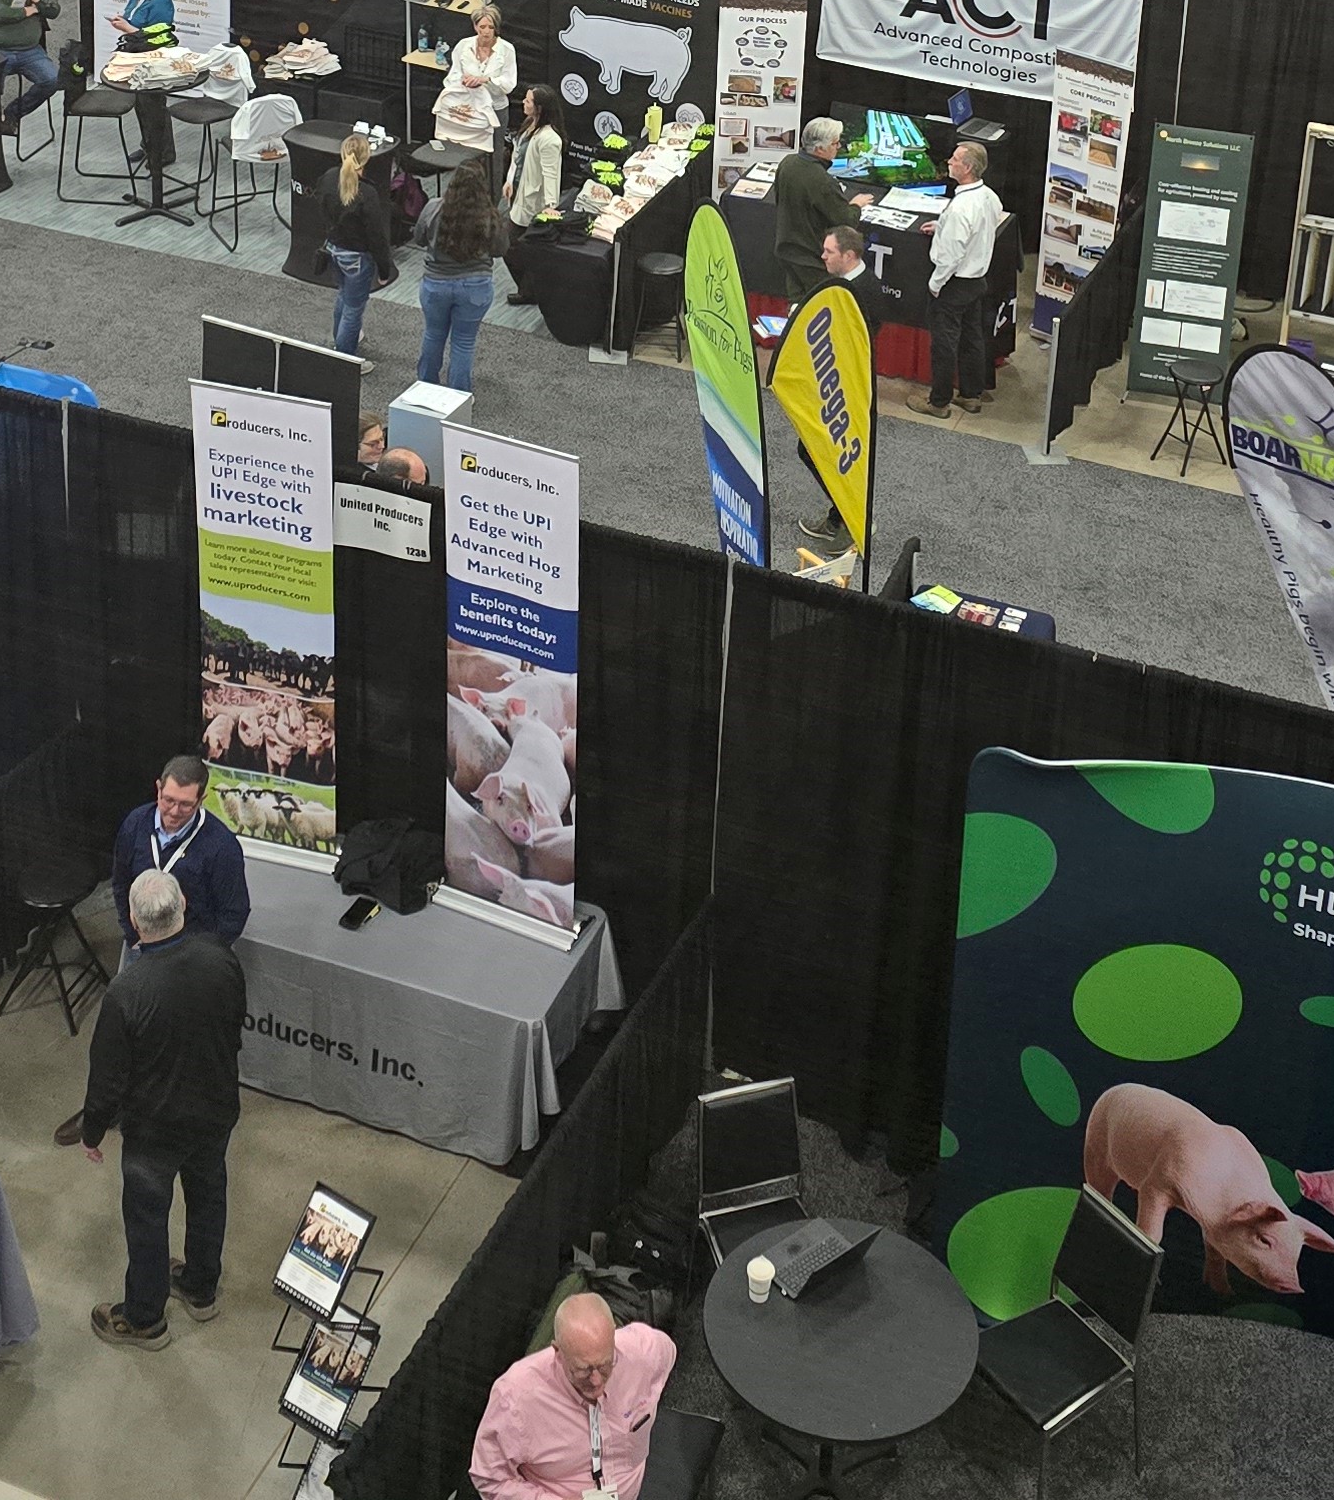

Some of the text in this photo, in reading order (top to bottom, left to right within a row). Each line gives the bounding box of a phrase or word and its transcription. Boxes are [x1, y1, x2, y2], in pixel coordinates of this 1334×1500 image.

[649, 2, 692, 18] VACCINES
[756, 17, 787, 25] PROCESS
[873, 21, 962, 50] Advanced
[919, 50, 1037, 84] Technologies
[805, 306, 863, 476] Omega-3
[210, 483, 303, 515] livestock
[340, 496, 424, 526] United Producers
[460, 493, 551, 531] Get the UPI
[203, 505, 313, 542] marketing
[373, 518, 391, 533] Inc.
